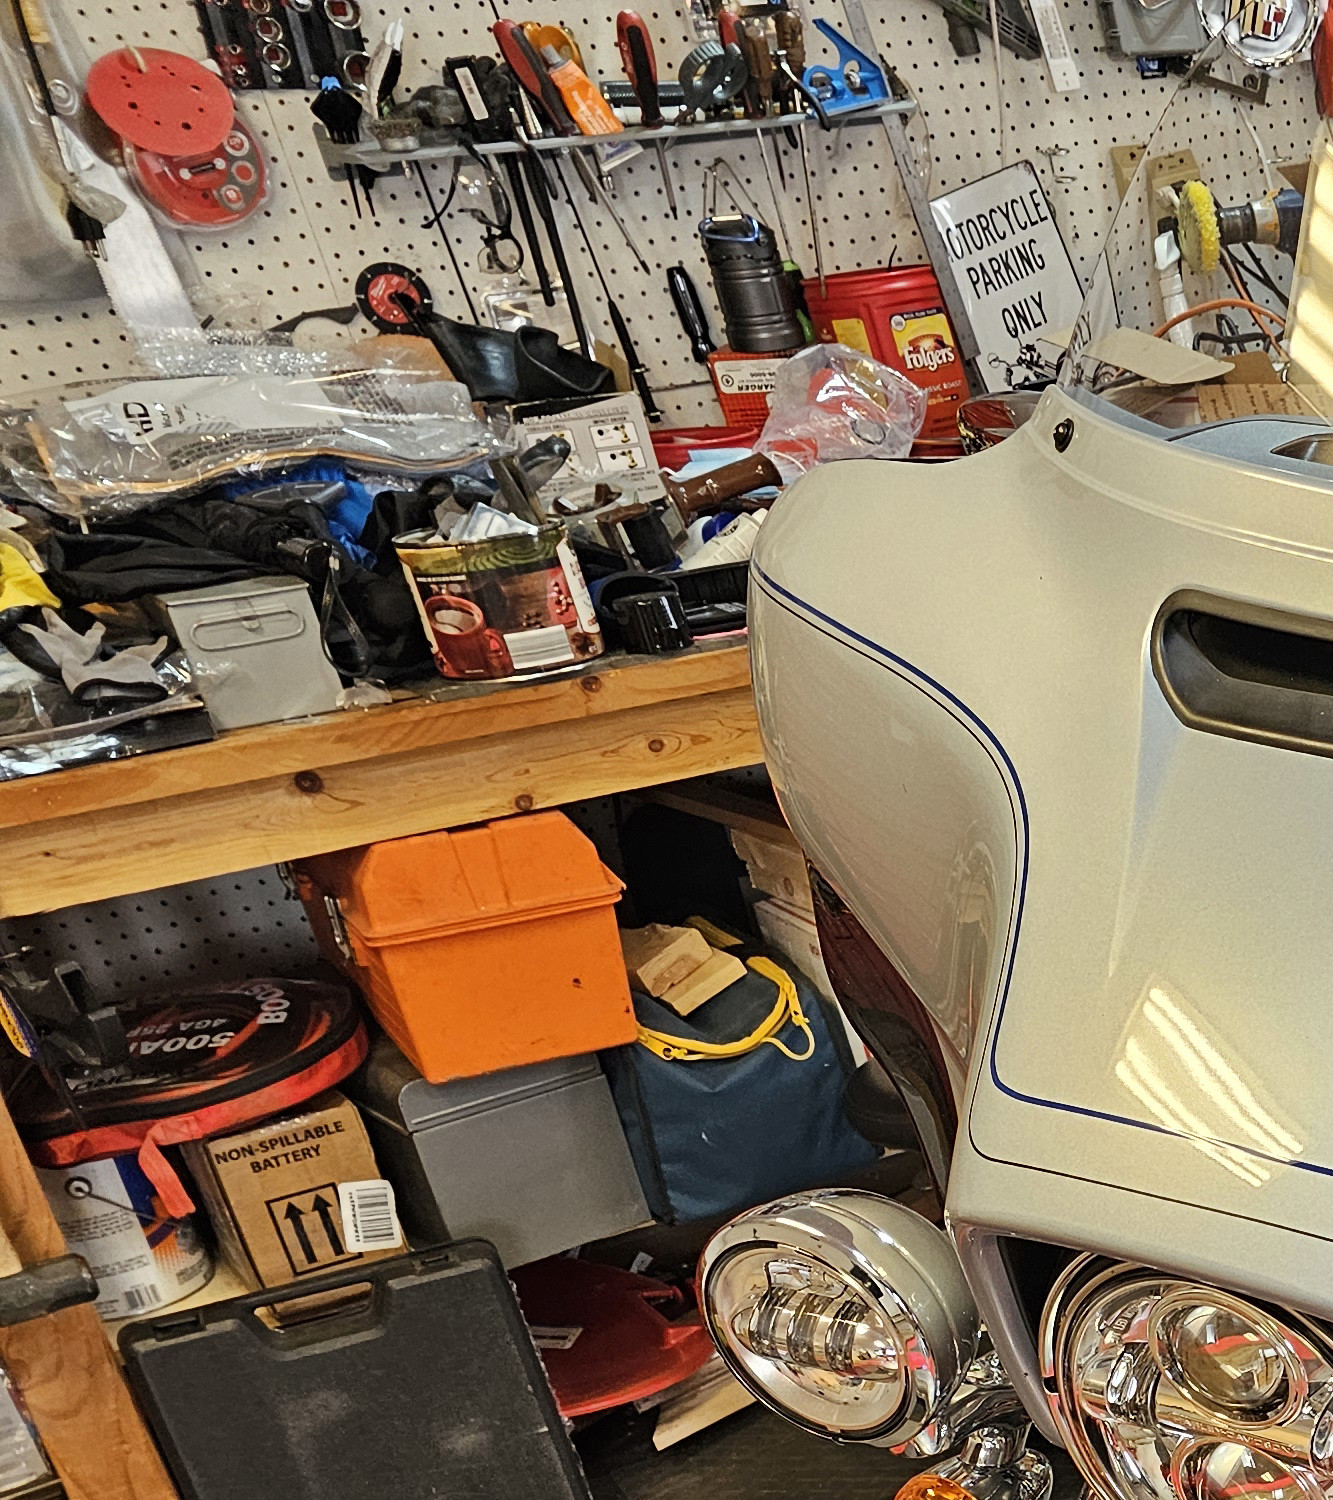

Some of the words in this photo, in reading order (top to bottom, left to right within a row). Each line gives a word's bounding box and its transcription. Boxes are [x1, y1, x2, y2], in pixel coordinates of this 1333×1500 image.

[946, 189, 1048, 262] OTORCYCLE
[966, 238, 1046, 300] PARKING
[1001, 291, 1048, 339] ONLY
[904, 346, 955, 372] Folgers
[737, 383, 777, 392] HARGER
[214, 1120, 345, 1165] NON-SPILLABLE
[250, 1144, 322, 1174] BATTERY
